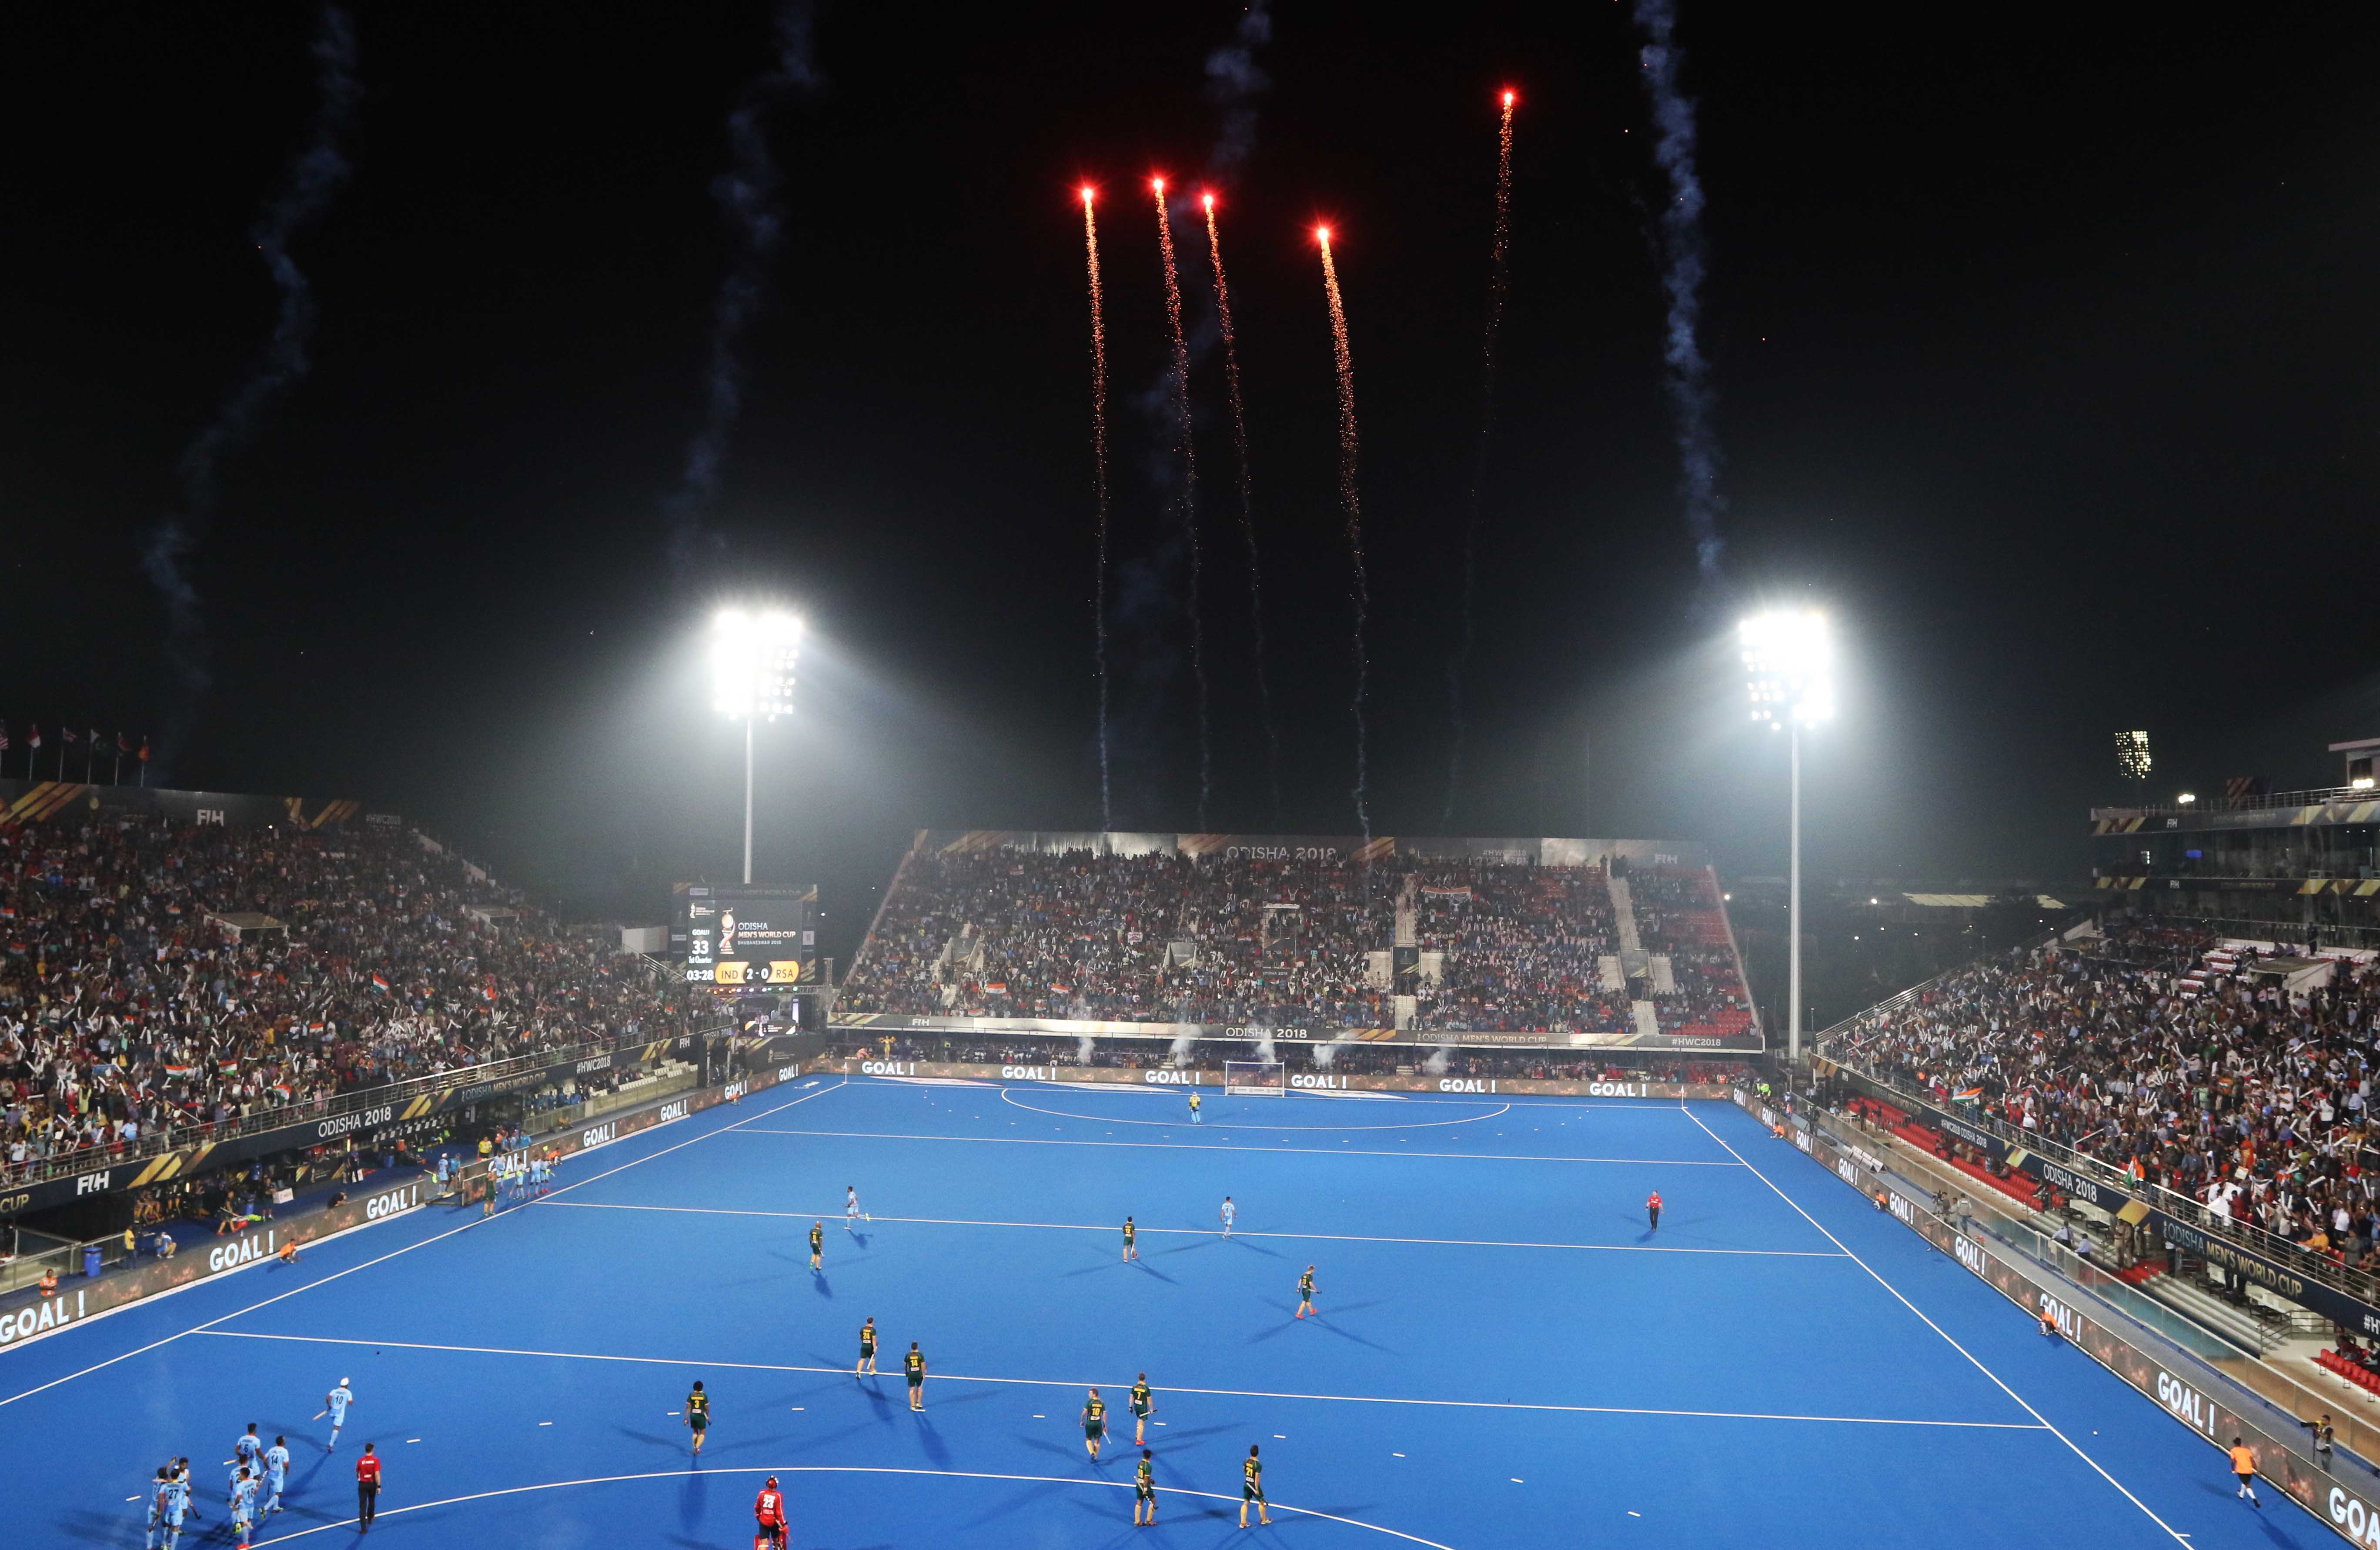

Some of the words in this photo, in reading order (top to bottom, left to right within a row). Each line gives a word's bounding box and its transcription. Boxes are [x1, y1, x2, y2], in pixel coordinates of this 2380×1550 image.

[692, 940, 709, 955] 33
[687, 970, 714, 981] 03:28
[721, 970, 738, 979] IND
[776, 969, 793, 978] RSA
[1226, 1027, 1272, 1037] ODISHA
[1277, 1028, 1307, 1038] 2018
[1423, 1033, 1459, 1042] ODISHA
[1672, 1038, 1721, 1046] #HWC2018
[576, 1056, 611, 1074] #HWC2018
[862, 1061, 905, 1075] GOAL
[779, 1066, 795, 1082] GOAL
[1002, 1066, 1045, 1080] GOAL
[1145, 1070, 1190, 1084] GOAL
[1291, 1074, 1336, 1089] GOAL
[1440, 1079, 1485, 1093] GOAL
[1590, 1082, 1635, 1097] GOAL
[661, 1104, 682, 1121] GOAL
[1762, 1107, 1773, 1127] GOAL
[318, 1112, 361, 1138] ODISHA
[364, 1106, 391, 1127] 2018
[584, 1124, 609, 1147] GOAL
[1796, 1130, 1810, 1152] GOAL
[1976, 1134, 1987, 1148] 2018
[1838, 1158, 1853, 1183] GOAL
[77, 1171, 109, 1196] FIH
[2043, 1163, 2073, 1192] ODISHA
[2076, 1178, 2097, 1203] 2018
[0, 1194, 29, 1213] CUP
[367, 1189, 408, 1219] GOAL
[1889, 1192, 1910, 1221] GOAL
[210, 1235, 262, 1272] GOAL
[1955, 1236, 1980, 1271] GOAL
[2168, 1223, 2205, 1255] ODISHA
[2206, 1241, 2236, 1269] MEN'S
[2237, 1255, 2276, 1286] WORLD
[2278, 1274, 2303, 1298] CUP
[0, 1297, 69, 1343] GOAL
[2363, 1314, 2380, 1335] #H
[335, 1395, 343, 1405] 10
[694, 1400, 699, 1408] 3
[2157, 1371, 2204, 1428] GOAL
[1092, 1407, 1100, 1416] 10
[244, 1444, 248, 1453] 6
[271, 1454, 278, 1465] 14
[1246, 1467, 1253, 1477] 21
[168, 1489, 178, 1500] 27
[762, 1498, 774, 1509] 23
[2329, 1487, 2380, 1550] GOA
